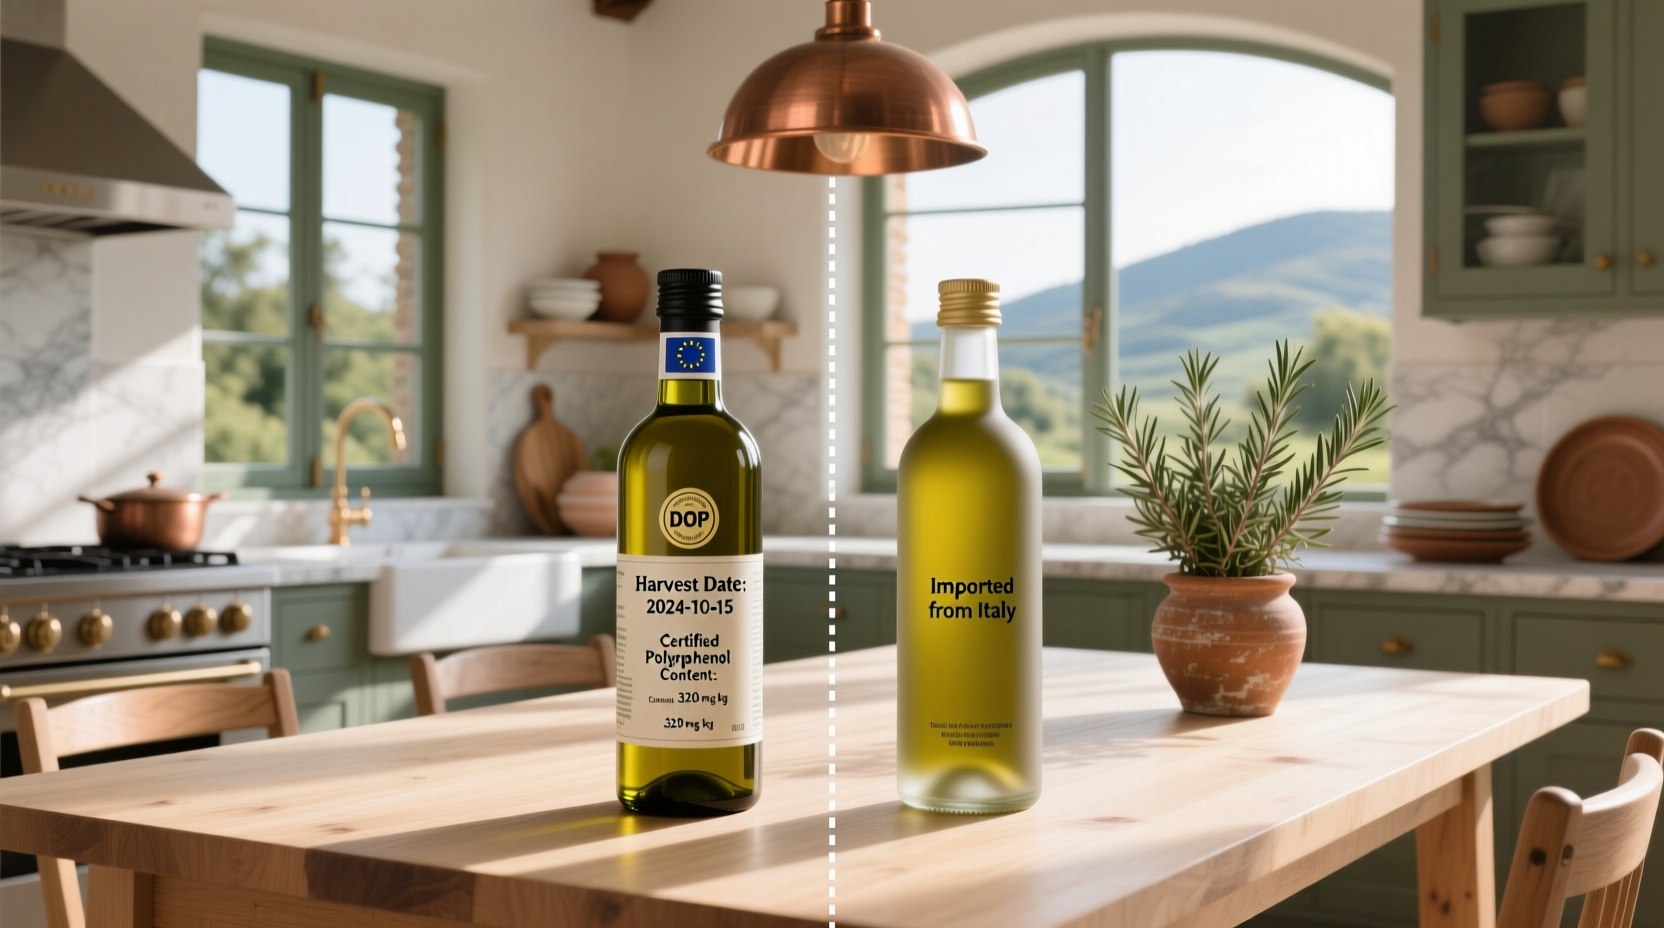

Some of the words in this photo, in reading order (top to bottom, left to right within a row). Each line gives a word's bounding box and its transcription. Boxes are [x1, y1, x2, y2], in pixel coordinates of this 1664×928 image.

[670, 510, 710, 528] DOP
[635, 575, 700, 593] Harvest
[703, 575, 747, 593] Date:
[931, 576, 1014, 600] Imported
[646, 598, 734, 615] 2024-10-15
[928, 600, 973, 619] from
[978, 600, 1017, 624] Italy
[659, 632, 720, 648] Certified
[677, 691, 700, 703] 320
[701, 695, 716, 705] mg
[663, 717, 684, 728] 320
